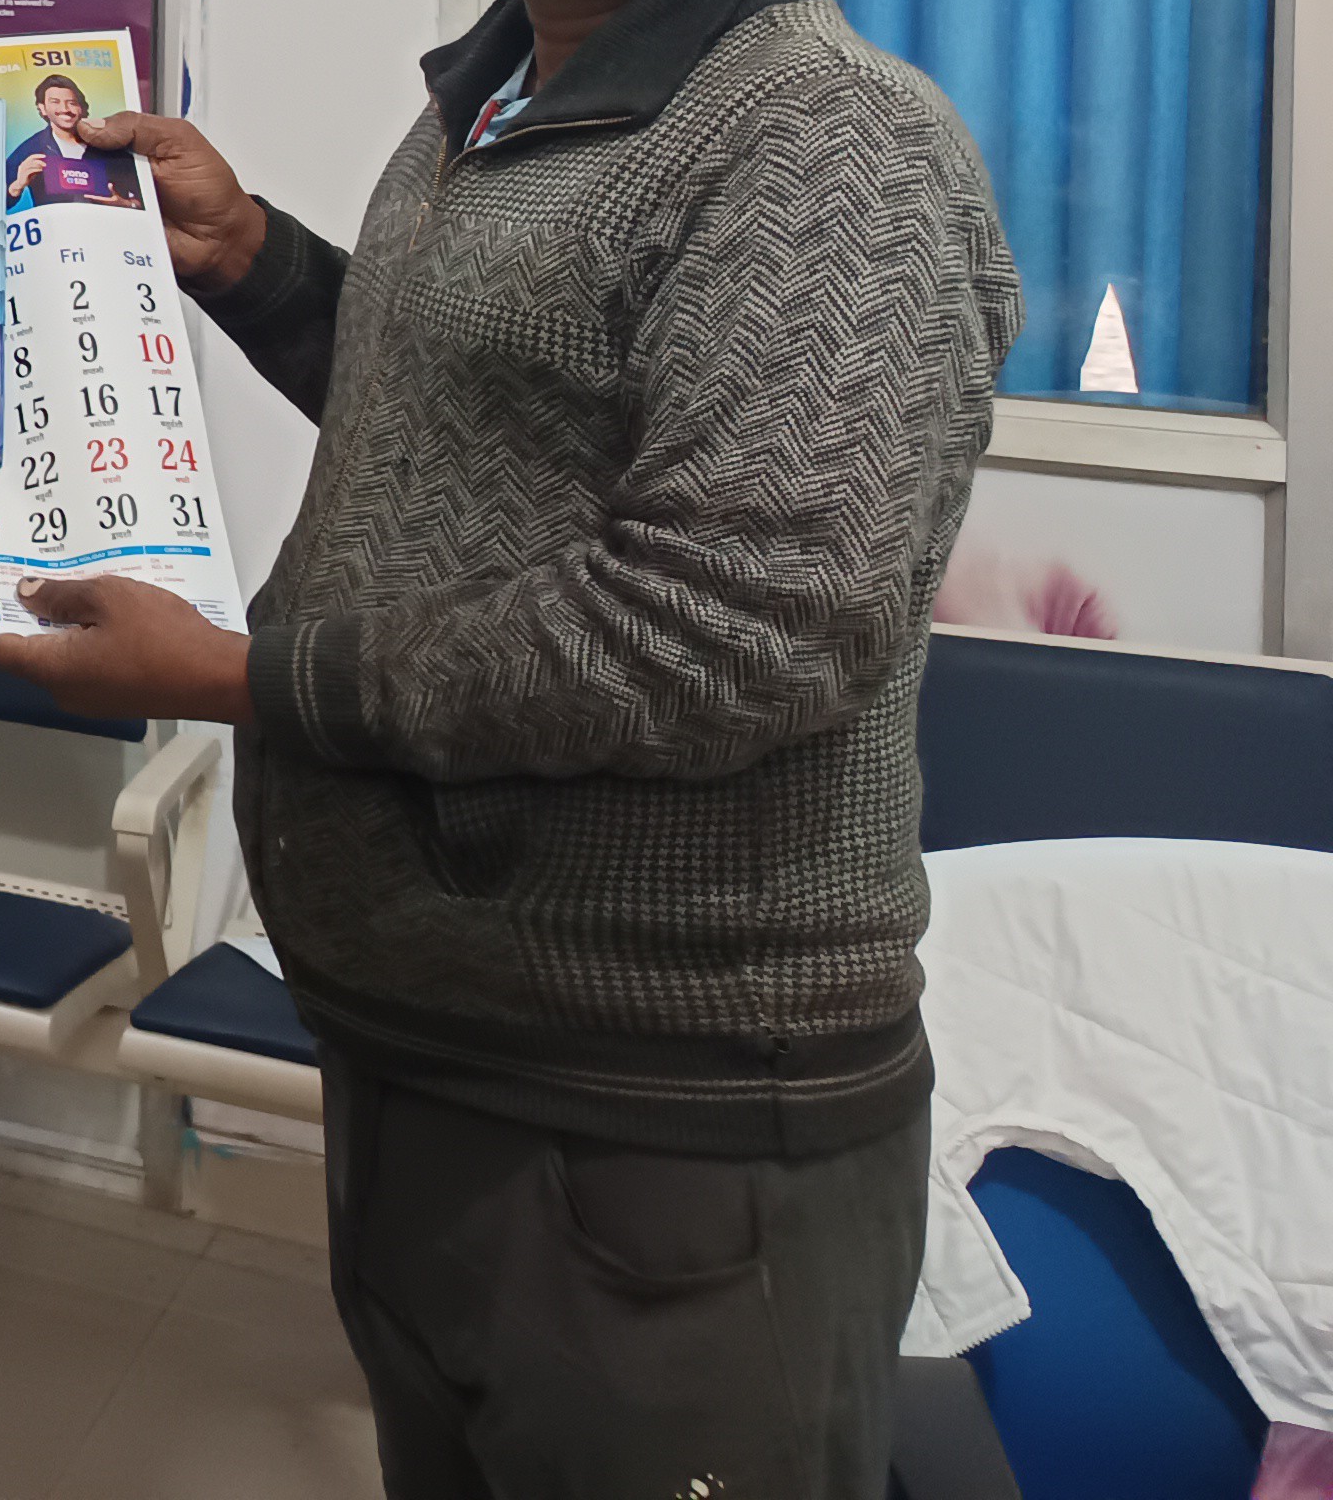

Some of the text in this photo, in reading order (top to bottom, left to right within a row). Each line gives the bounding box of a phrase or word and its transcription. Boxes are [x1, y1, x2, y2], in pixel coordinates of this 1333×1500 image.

[31, 50, 71, 67] SBI
[74, 49, 111, 59] DESH
[85, 59, 112, 69] FAN
[62, 169, 89, 179] yono
[6, 218, 42, 252] 26
[60, 248, 86, 264] Fri
[123, 251, 154, 268] Sat
[7, 280, 157, 326] 1 2 3
[13, 331, 175, 379] 8 9 10
[14, 384, 182, 435] 15 16 17
[21, 437, 198, 490] 22 23 24
[28, 507, 68, 544] 29
[96, 493, 138, 530] 30
[169, 493, 209, 529] 31
